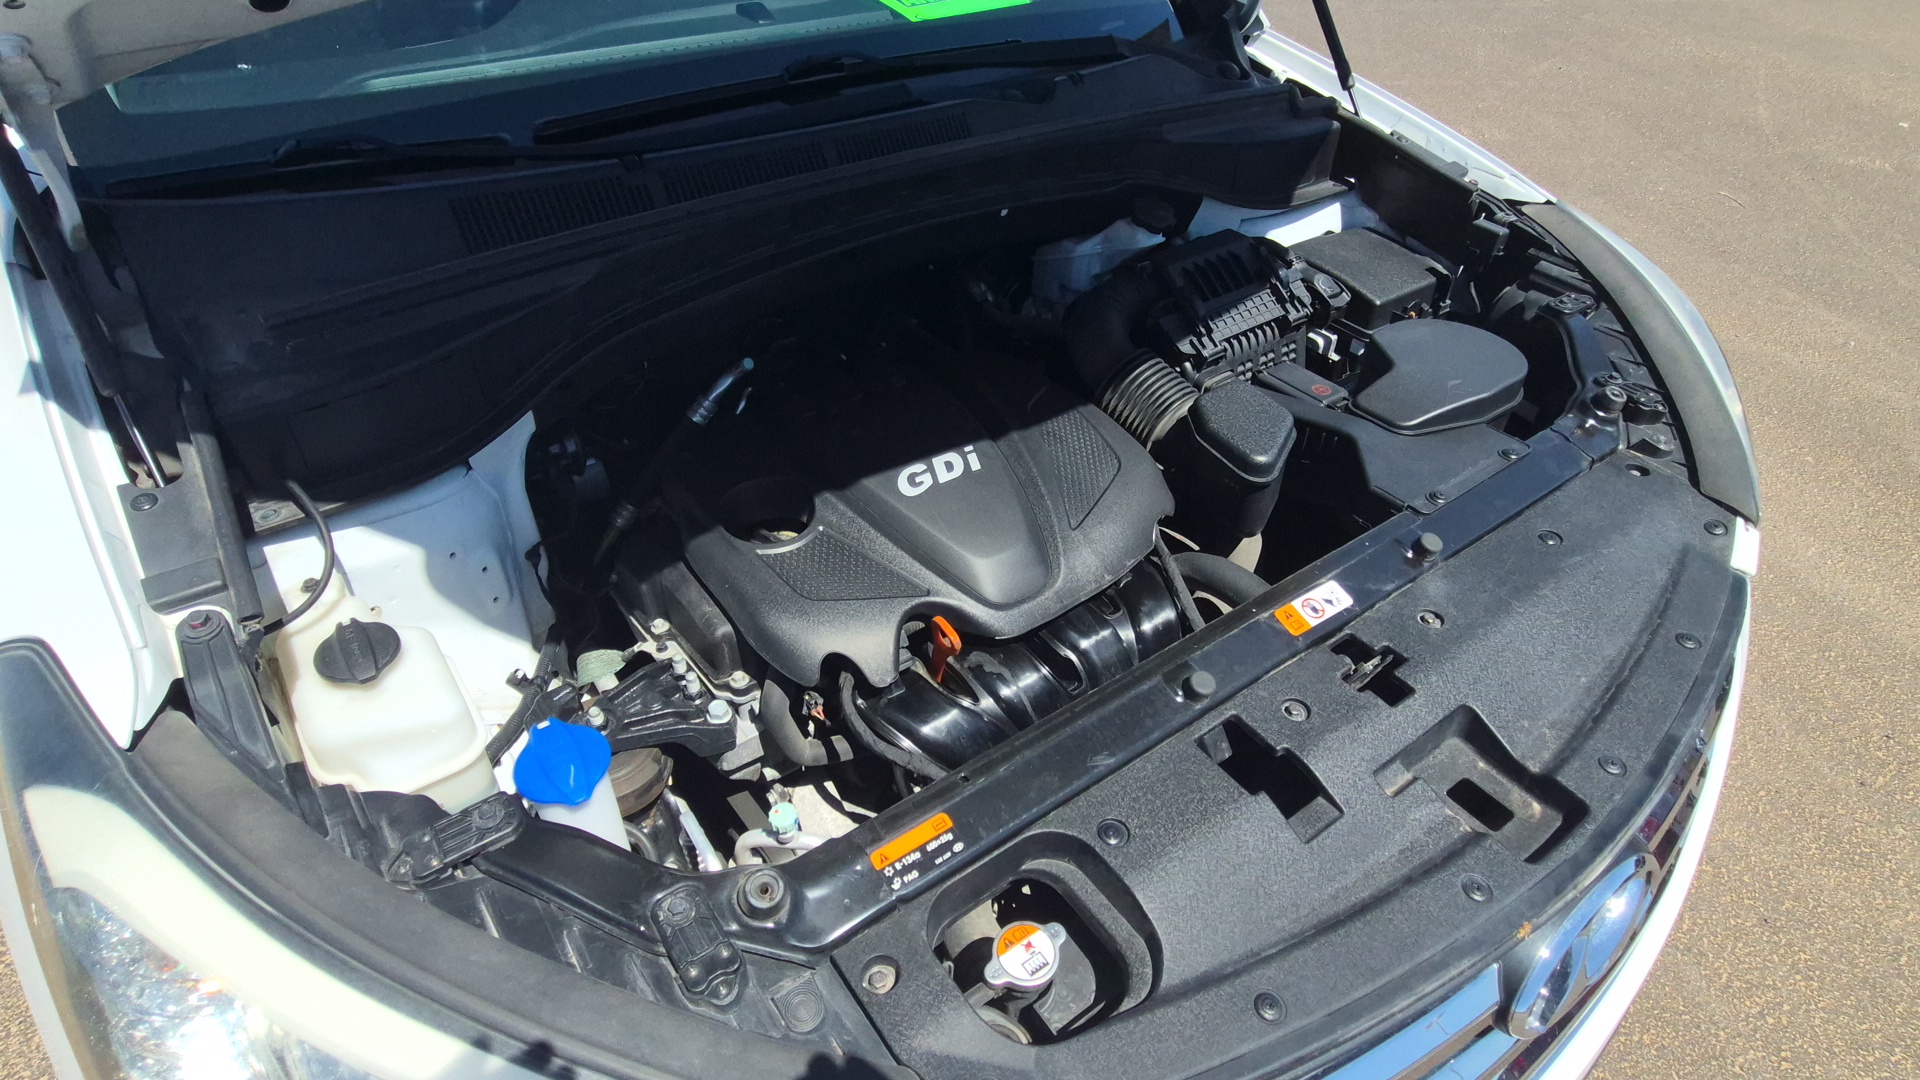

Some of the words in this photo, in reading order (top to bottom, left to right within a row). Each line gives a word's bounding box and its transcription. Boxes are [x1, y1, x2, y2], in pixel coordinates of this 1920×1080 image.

[897, 445, 981, 496] GDi
[894, 851, 921, 870] R-134a
[903, 870, 919, 883] PAG
